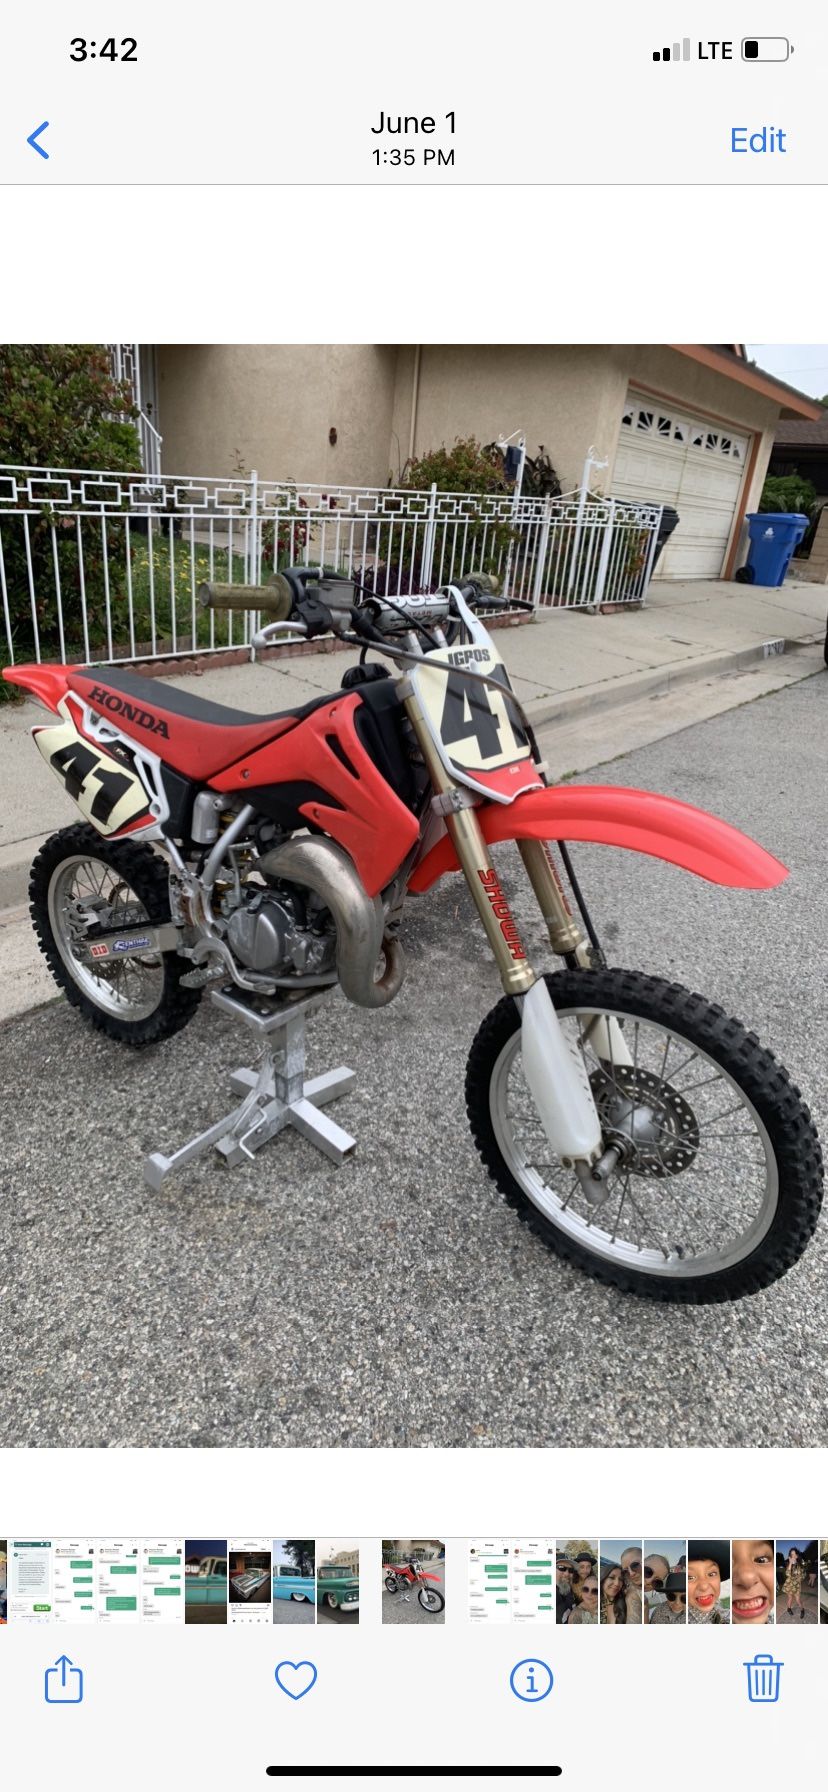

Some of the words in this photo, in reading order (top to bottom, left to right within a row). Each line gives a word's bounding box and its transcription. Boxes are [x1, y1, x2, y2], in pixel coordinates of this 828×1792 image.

[69, 37, 138, 63] 3:42
[698, 41, 733, 60] LTE
[370, 111, 436, 135] June
[445, 111, 456, 135] 1
[731, 127, 787, 153] Edit
[372, 148, 416, 166] 1:35
[423, 148, 455, 166] PM
[88, 685, 170, 740] HONDA
[439, 662, 529, 760] 41
[50, 741, 135, 826] 41
[477, 868, 527, 960] SHOWA
